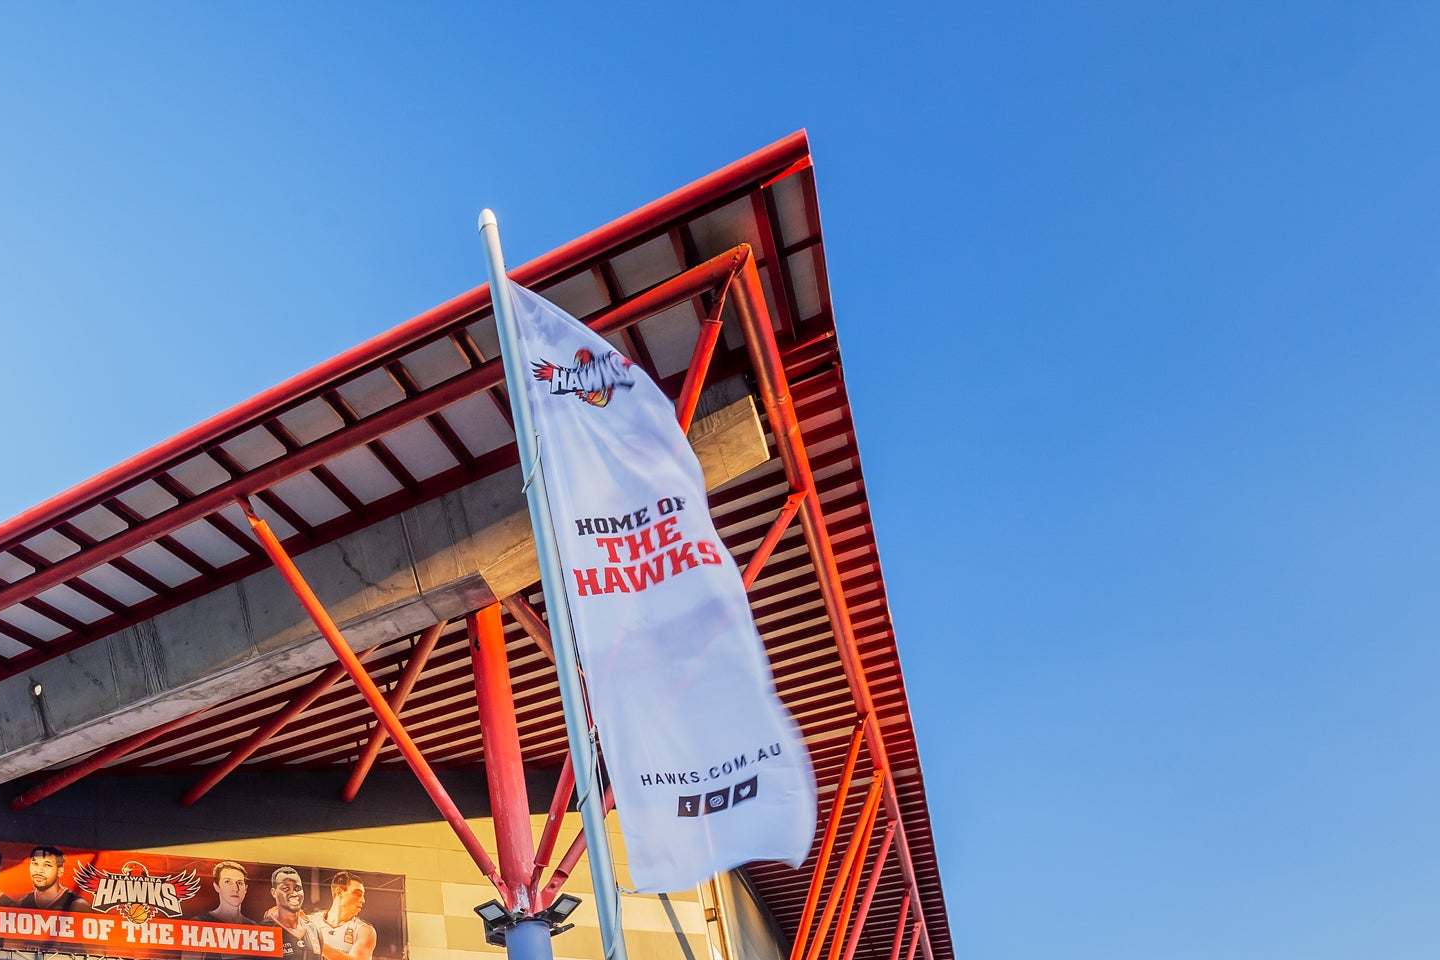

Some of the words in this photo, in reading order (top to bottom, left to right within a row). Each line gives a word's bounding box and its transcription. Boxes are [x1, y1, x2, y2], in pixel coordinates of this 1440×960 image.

[575, 507, 651, 536] HOME
[657, 496, 686, 516] OF
[596, 516, 682, 563] THE
[573, 540, 722, 597] HAWKS
[640, 742, 782, 787] HAWKS.COM.AU
[94, 878, 181, 914] HAWKS
[111, 874, 161, 884] ILLAWARRA
[82, 917, 115, 942] OF
[122, 921, 174, 946] THE
[181, 925, 276, 952] HAWKS
